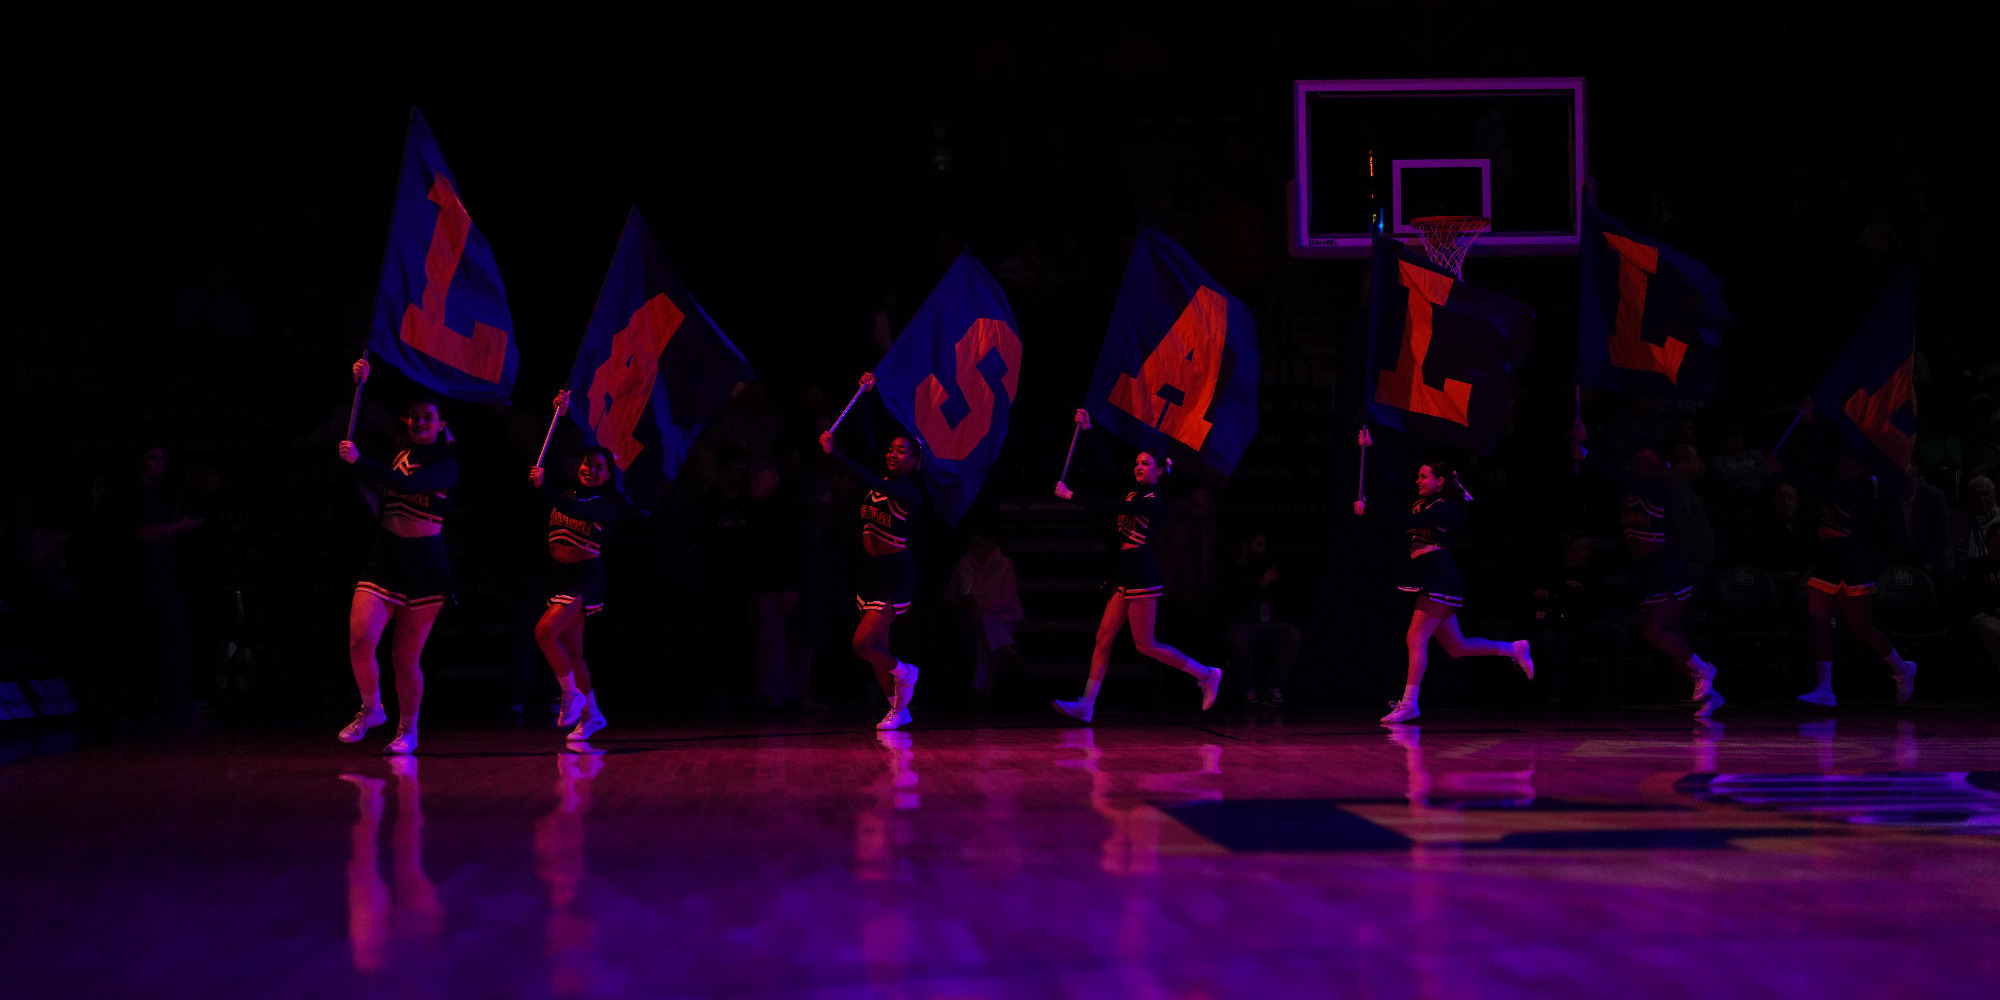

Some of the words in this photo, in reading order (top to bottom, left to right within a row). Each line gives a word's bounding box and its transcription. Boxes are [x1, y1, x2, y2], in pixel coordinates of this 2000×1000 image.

[400, 168, 508, 384] L
[1374, 258, 1472, 427] L
[1602, 231, 1688, 386] L
[914, 317, 1023, 461] S
[1107, 284, 1228, 451] A
